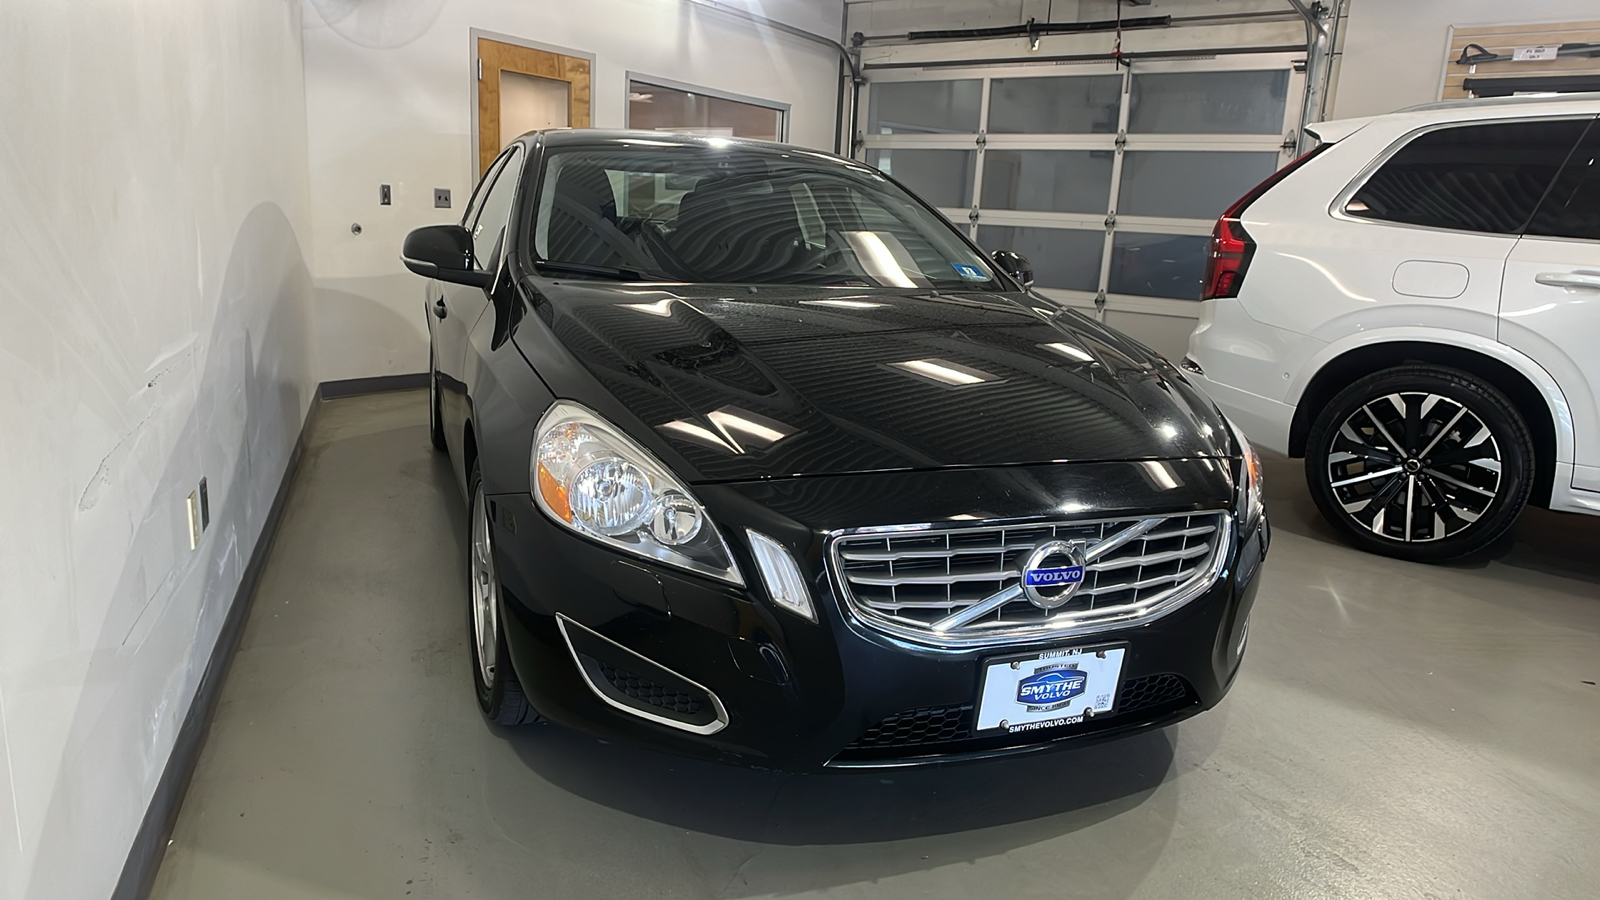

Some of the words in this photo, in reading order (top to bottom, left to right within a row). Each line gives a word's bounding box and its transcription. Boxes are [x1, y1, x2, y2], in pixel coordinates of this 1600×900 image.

[1030, 570, 1081, 583] VOLVO
[1072, 648, 1083, 656] NJ
[1020, 680, 1081, 696] SMYTHE
[1034, 690, 1071, 701] VOLVO
[1009, 716, 1084, 733] SMYTHEVOLVO.COM
